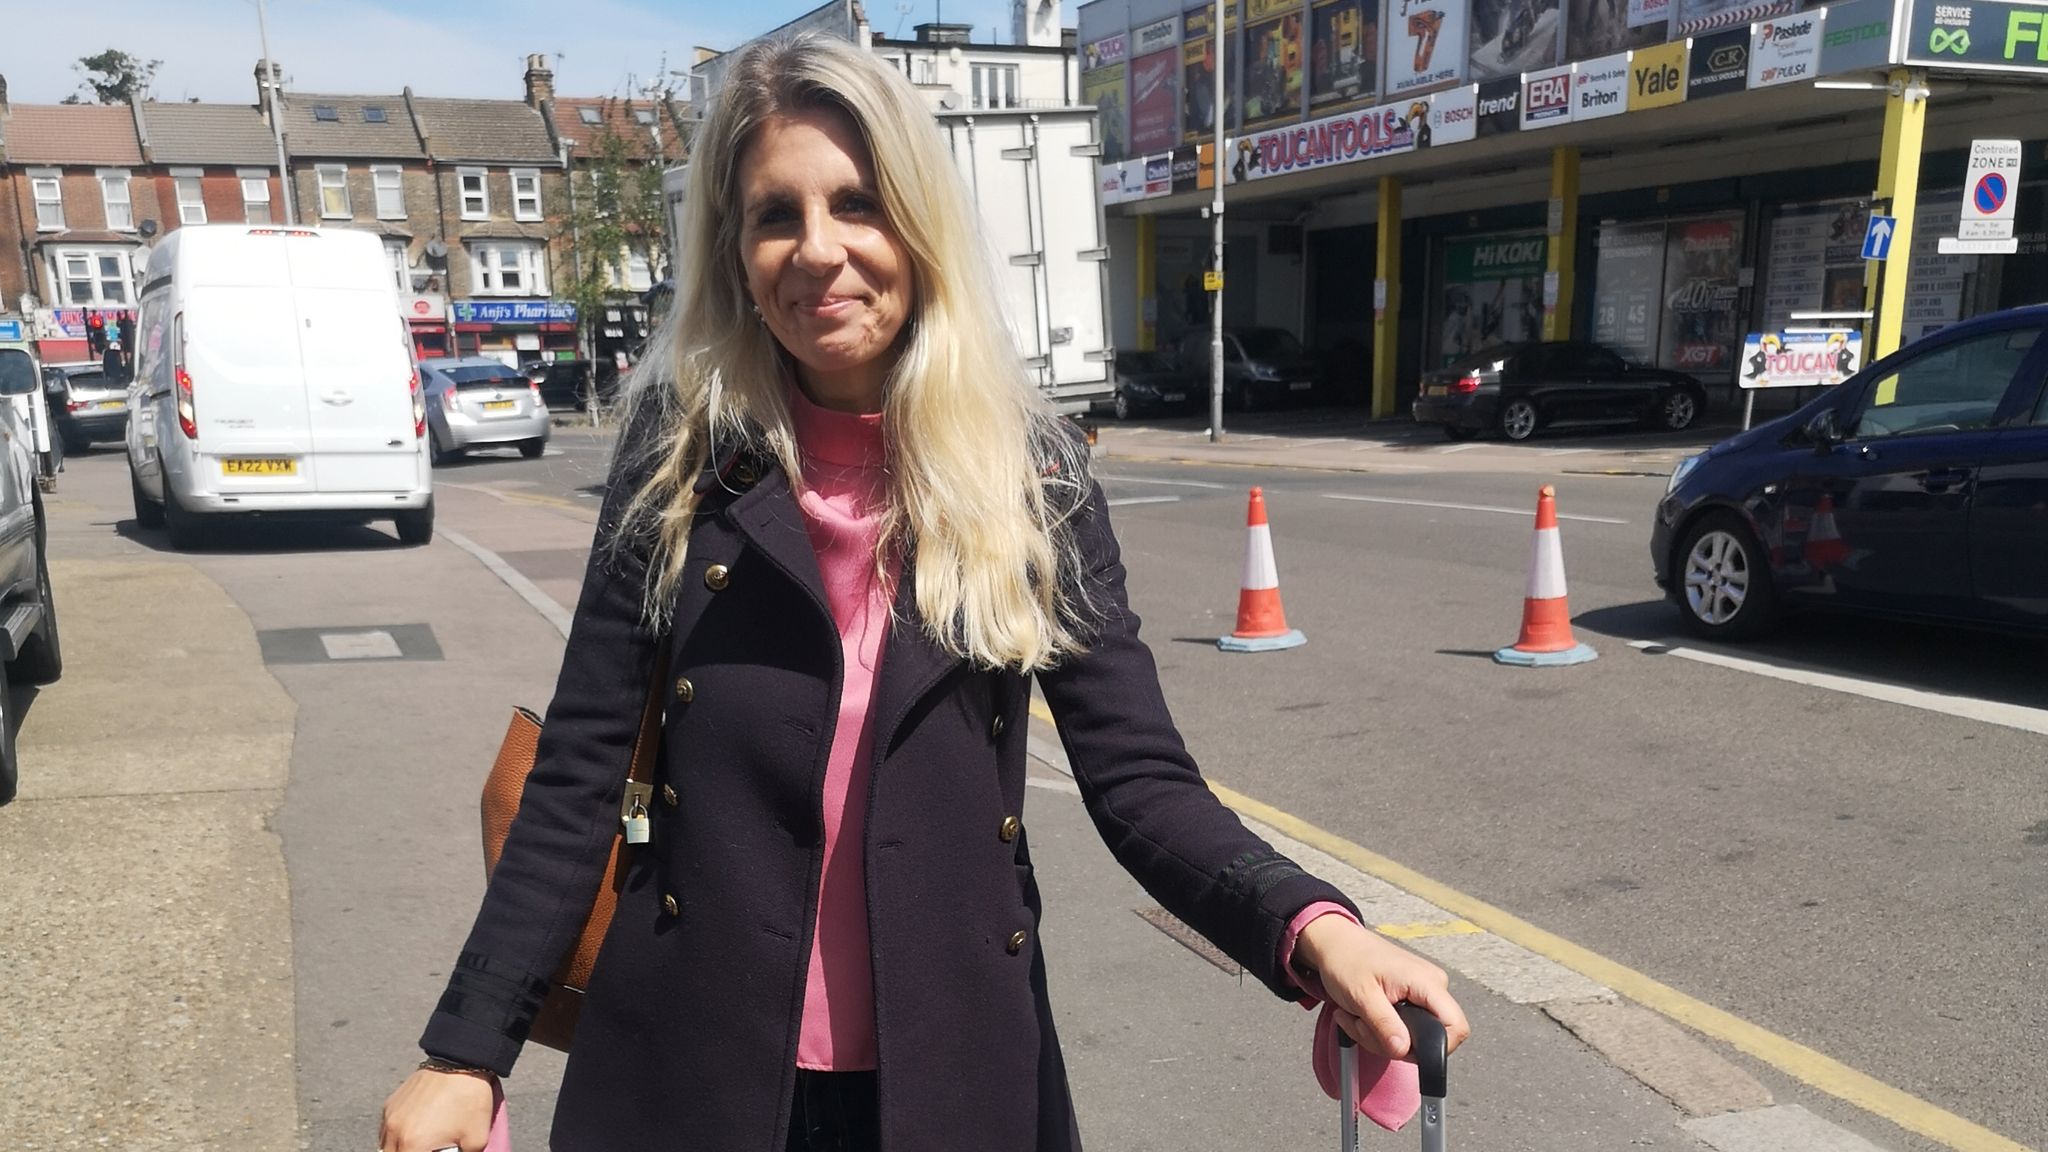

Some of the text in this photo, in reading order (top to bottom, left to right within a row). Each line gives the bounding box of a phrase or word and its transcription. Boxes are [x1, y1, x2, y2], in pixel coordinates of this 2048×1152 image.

[1935, 5, 1972, 19] SERVICE
[1773, 20, 1813, 42] Paslode
[1635, 63, 1680, 96] Yale
[1777, 64, 1807, 79] PULSA
[1529, 77, 1567, 109] ERA
[1581, 90, 1618, 110] Briton
[1479, 92, 1518, 116] trend
[1444, 106, 1474, 125] BOSCH
[1974, 144, 2018, 155] Controlled
[1972, 157, 2004, 169] ZONE
[481, 304, 512, 324] Anji's
[1628, 305, 1646, 325] 45
[1680, 346, 1718, 363] XGT
[1767, 352, 1838, 374] TOUCAN
